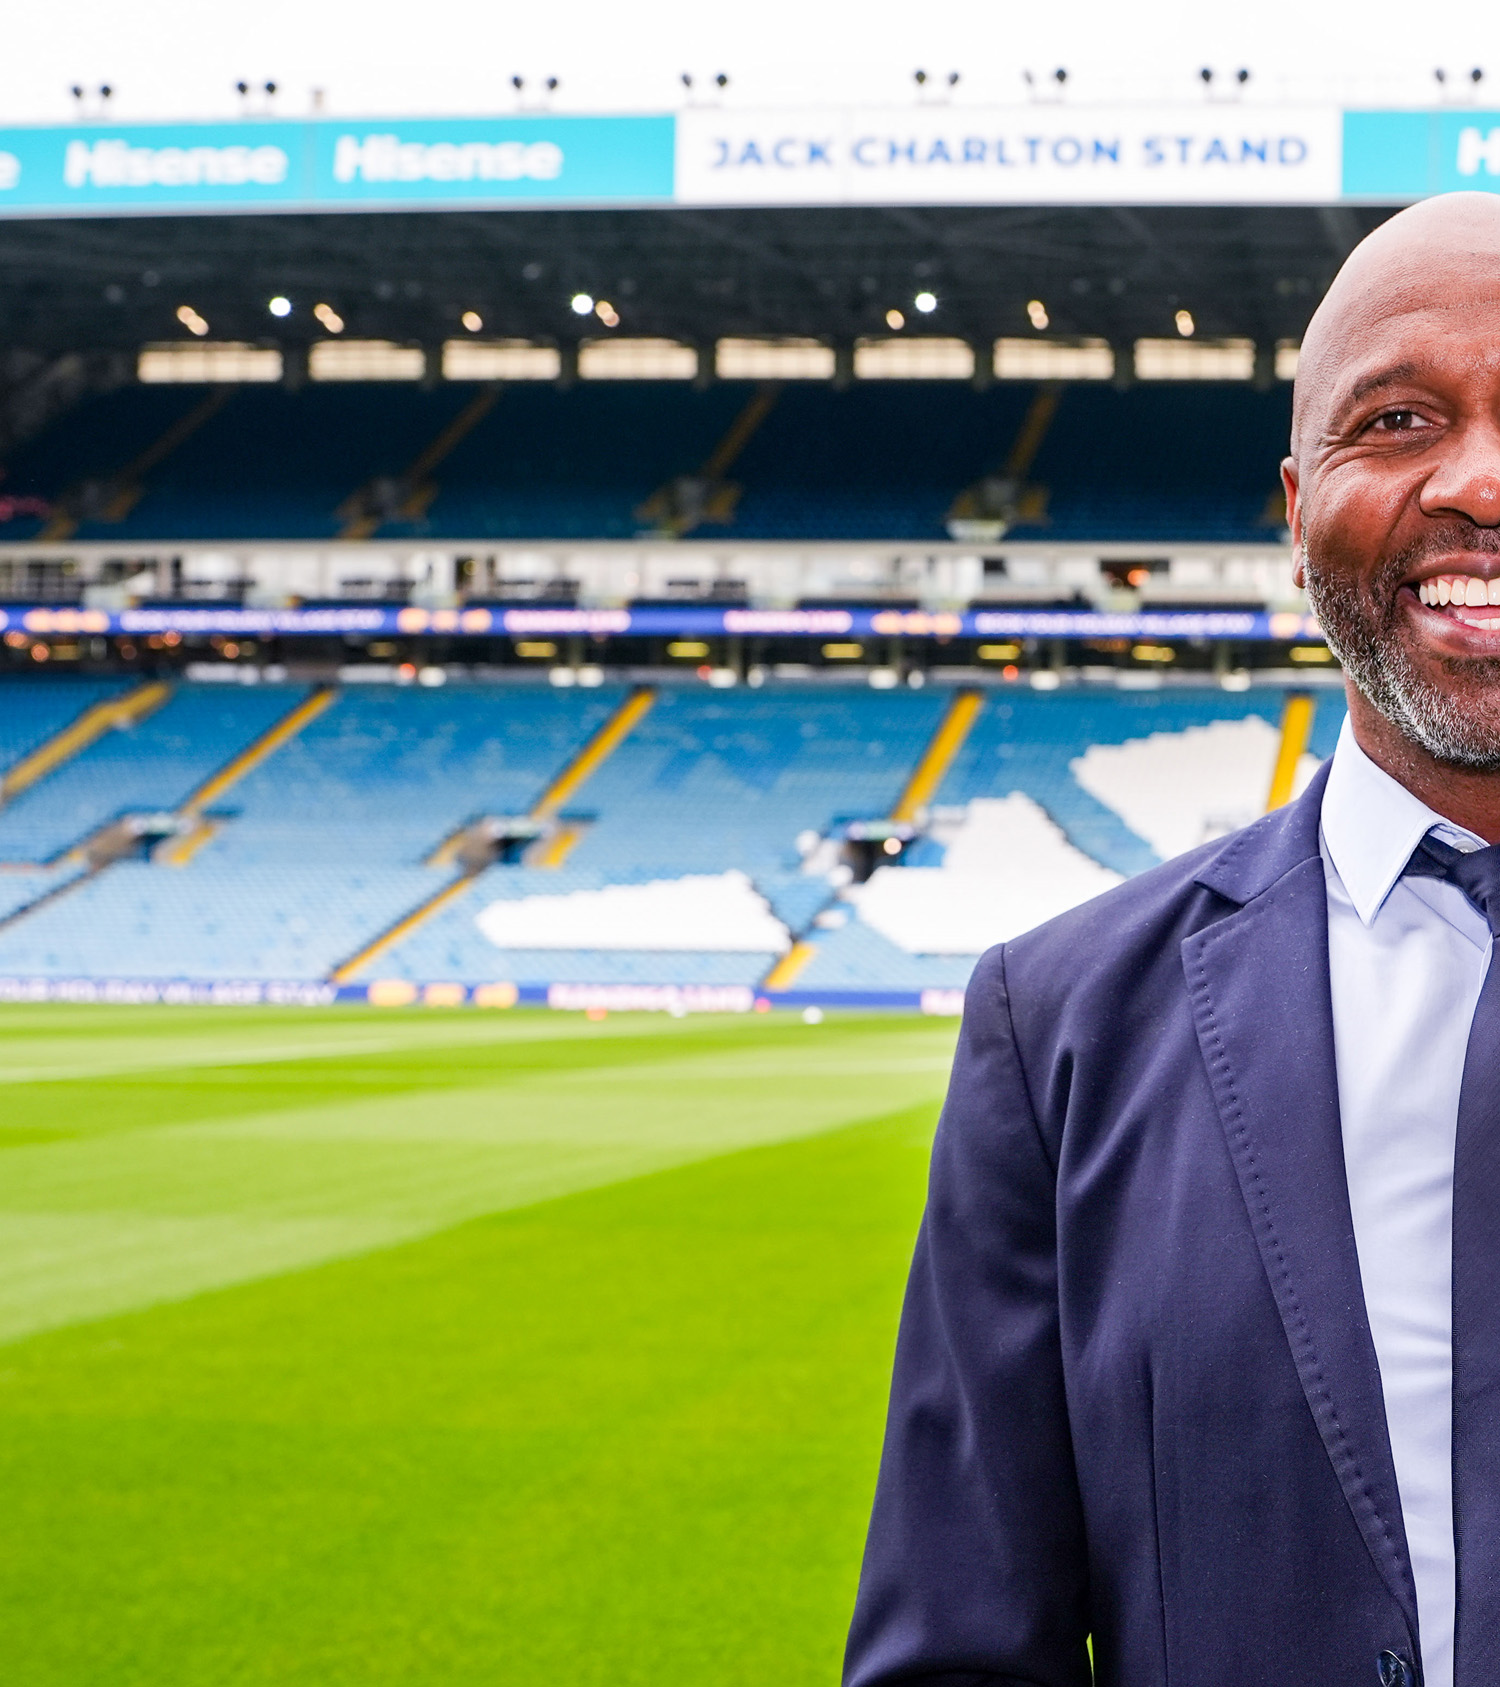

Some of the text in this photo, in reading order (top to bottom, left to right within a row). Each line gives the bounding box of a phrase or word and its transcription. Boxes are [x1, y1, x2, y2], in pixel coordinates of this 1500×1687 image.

[64, 139, 288, 188] Hisense
[333, 134, 563, 183] Hisense
[711, 136, 1309, 169] JACK CHARLTON STAND
